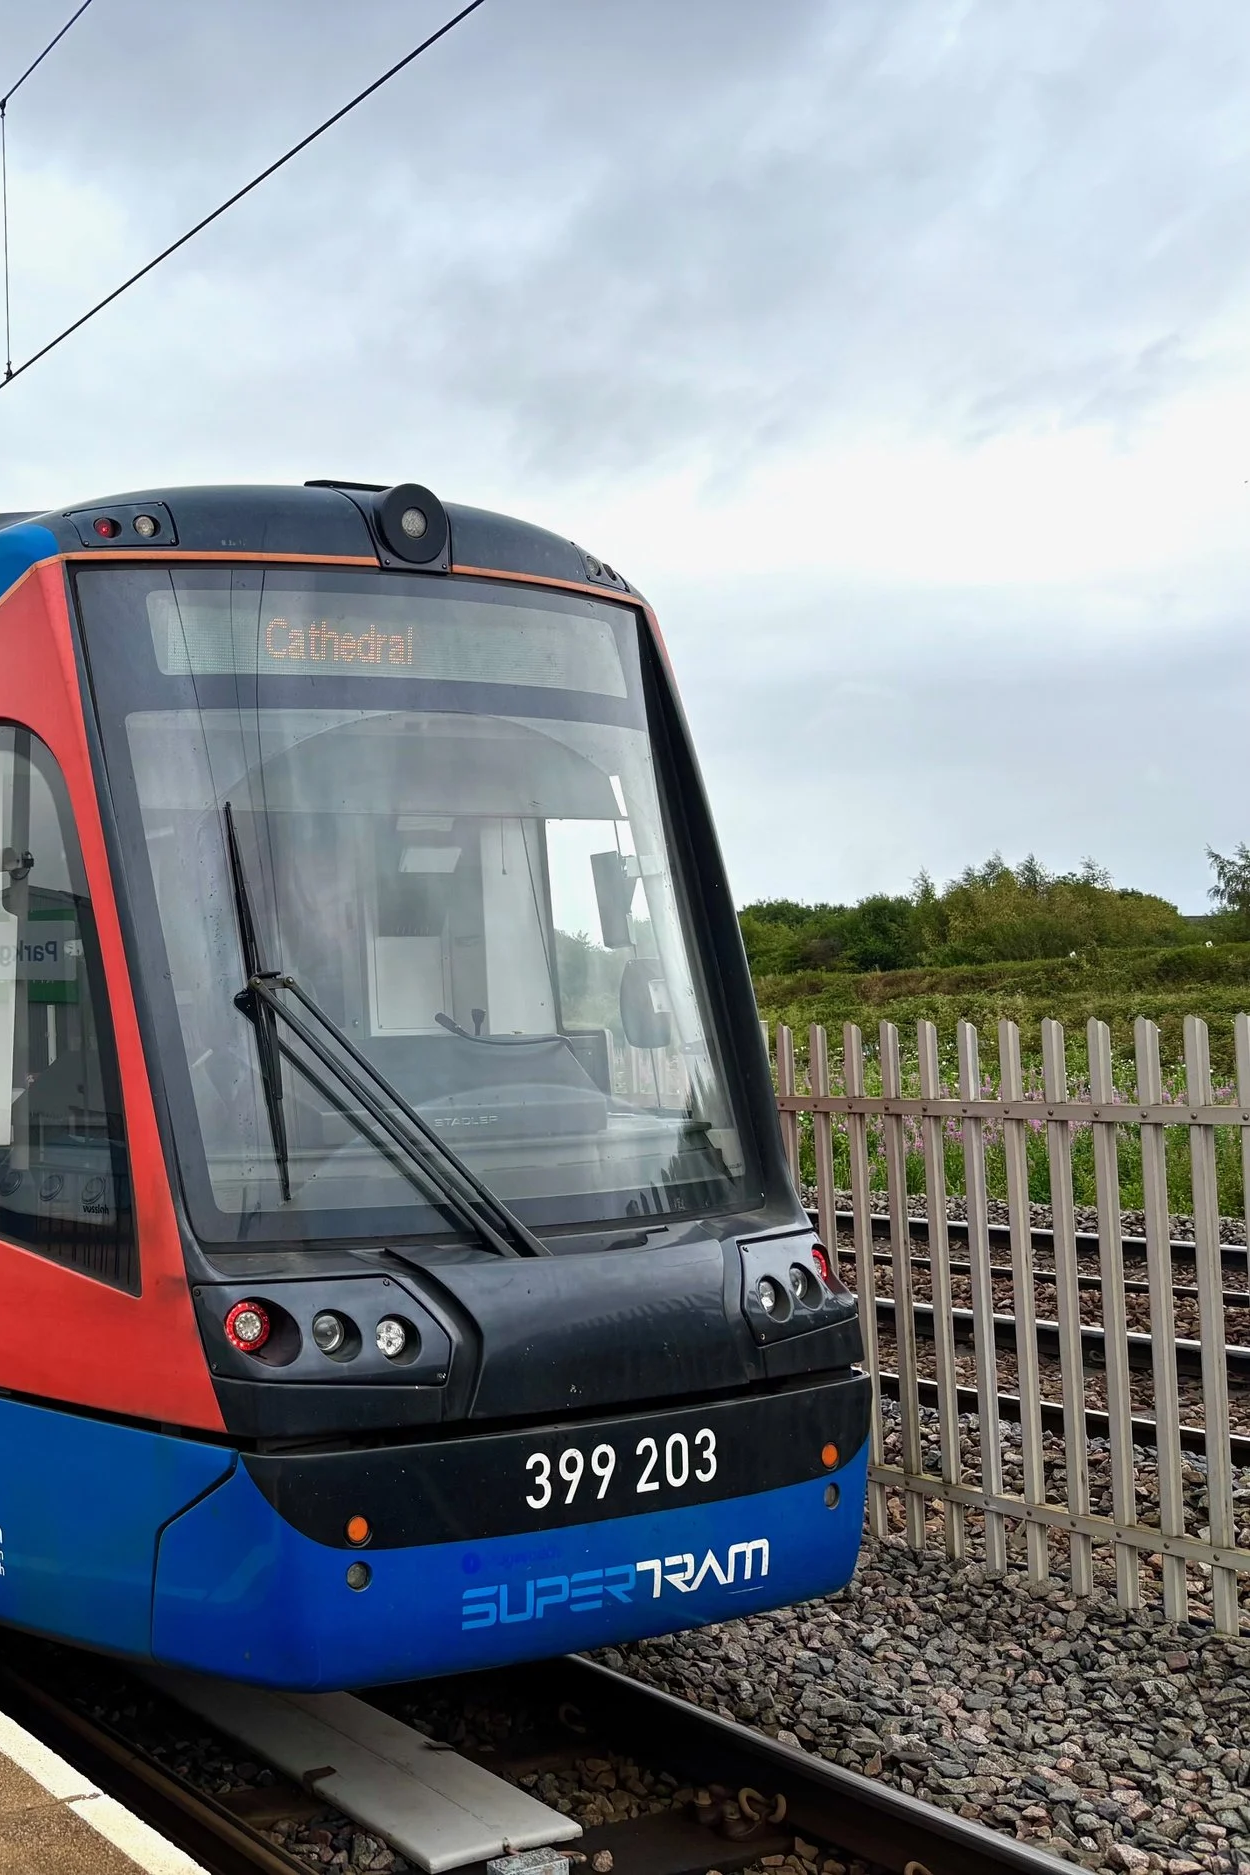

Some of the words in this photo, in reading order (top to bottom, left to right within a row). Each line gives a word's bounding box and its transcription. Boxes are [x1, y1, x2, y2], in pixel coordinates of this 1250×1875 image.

[265, 616, 414, 665] Cathedral
[525, 1443, 616, 1509] 399
[636, 1428, 717, 1493] 203
[461, 1538, 769, 1630] SUPERTRAM
